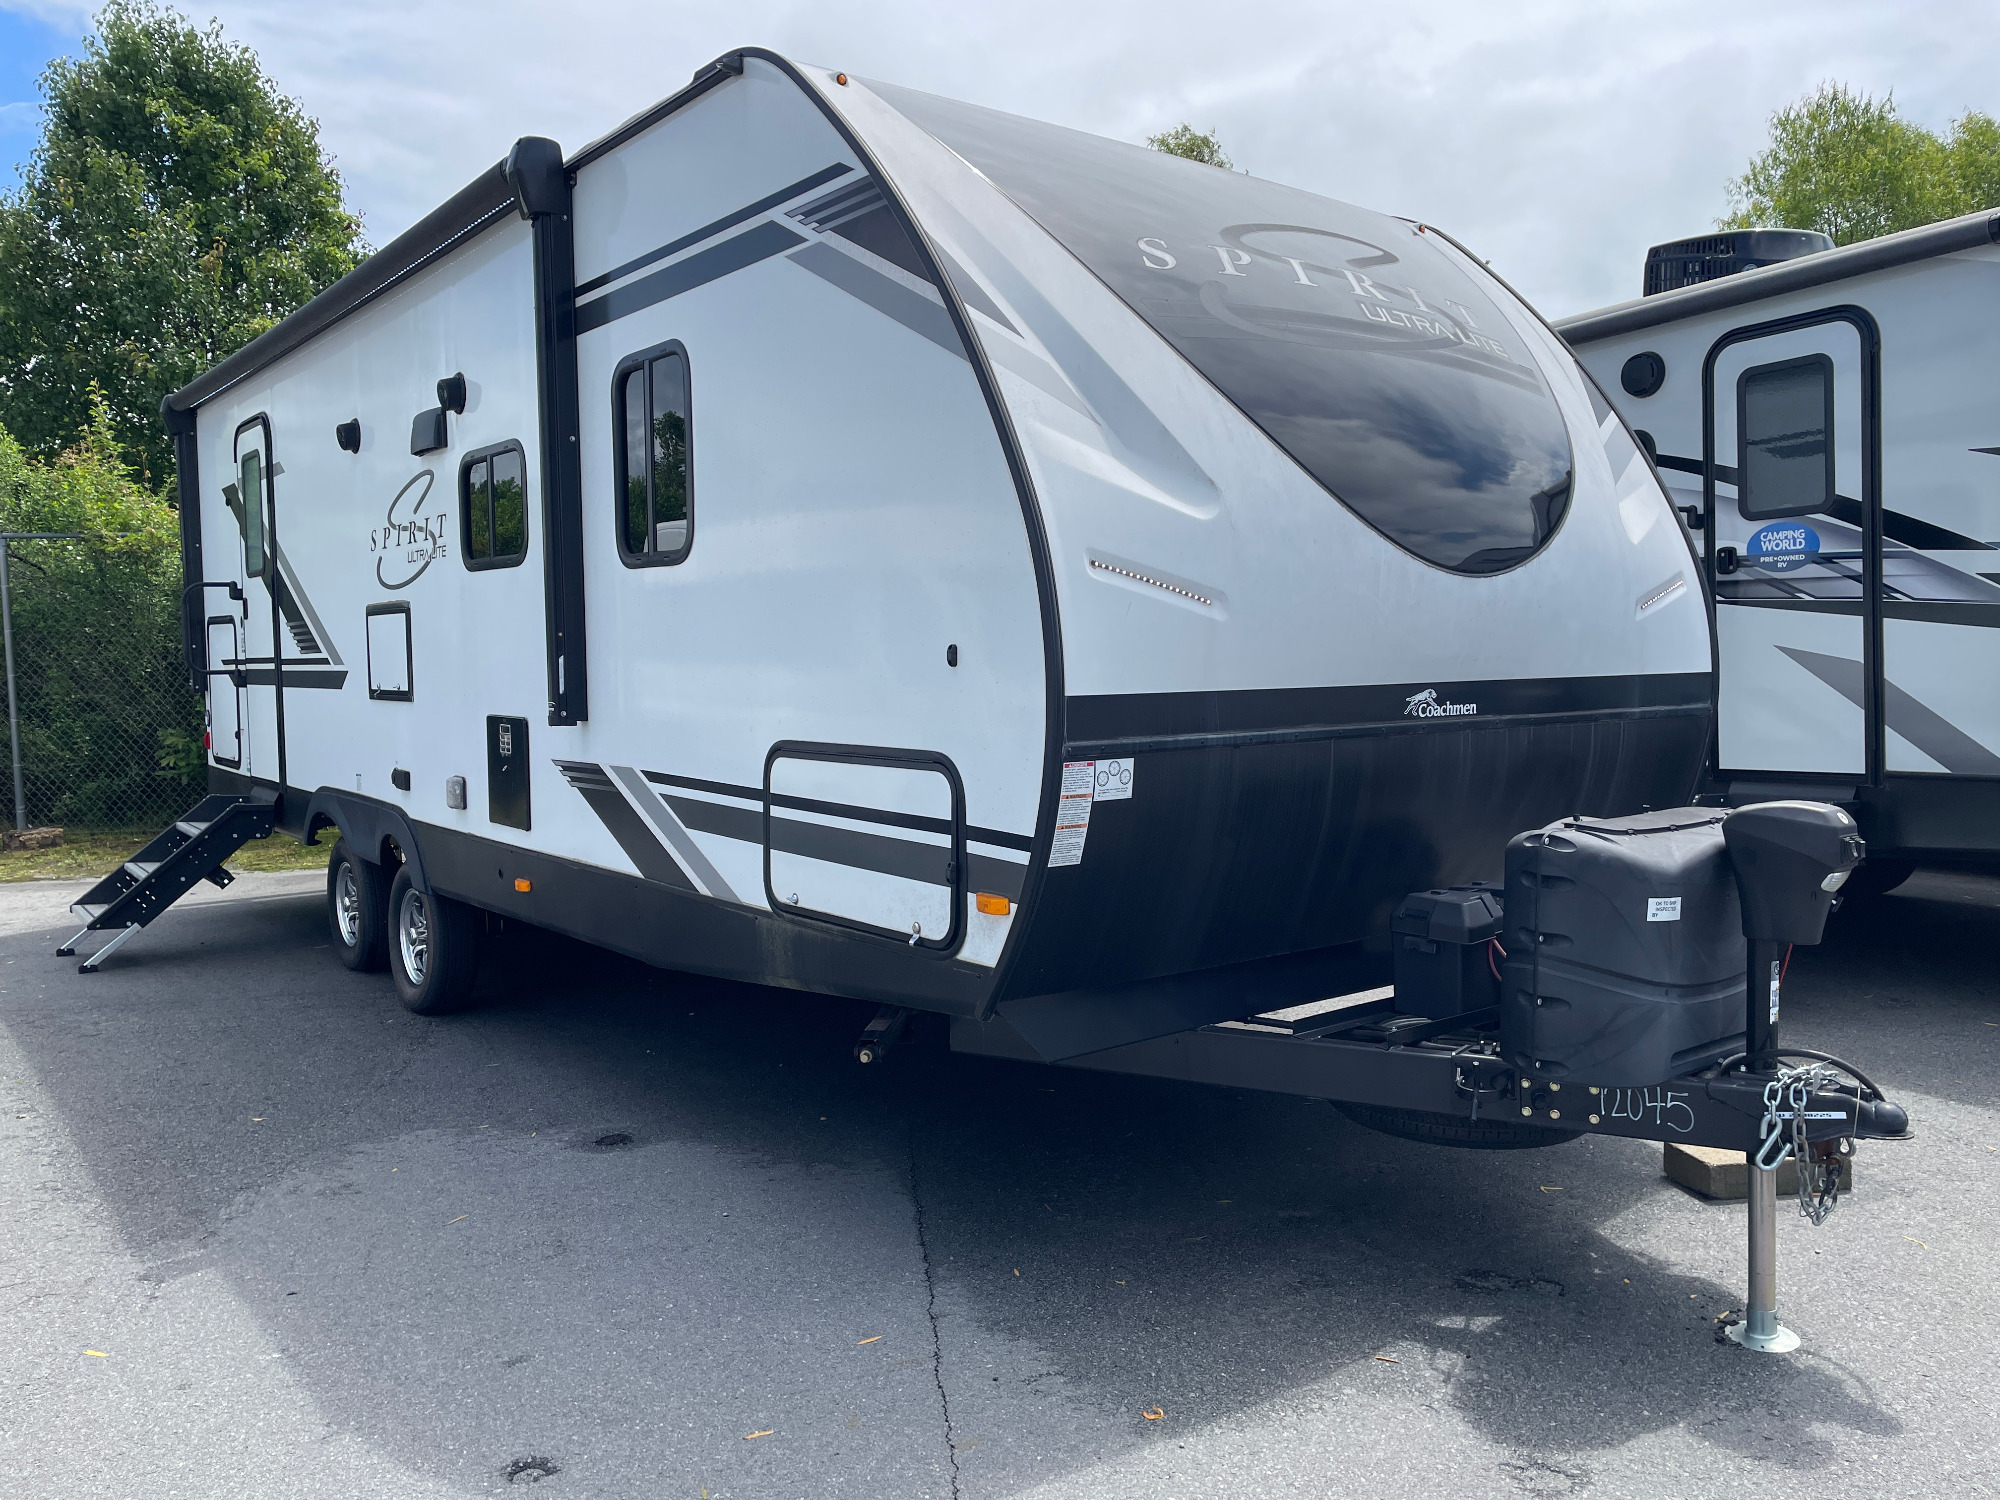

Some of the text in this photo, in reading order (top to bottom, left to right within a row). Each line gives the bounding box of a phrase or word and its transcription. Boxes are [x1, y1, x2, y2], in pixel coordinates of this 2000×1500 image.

[1136, 237, 1482, 332] SPIRIT
[370, 513, 447, 552] SPIRIT
[1760, 529, 1805, 542] CAMPING
[1760, 539, 1805, 552] WORLD
[1418, 701, 1477, 718] Coachmen
[1600, 1086, 1695, 1132] 12045
